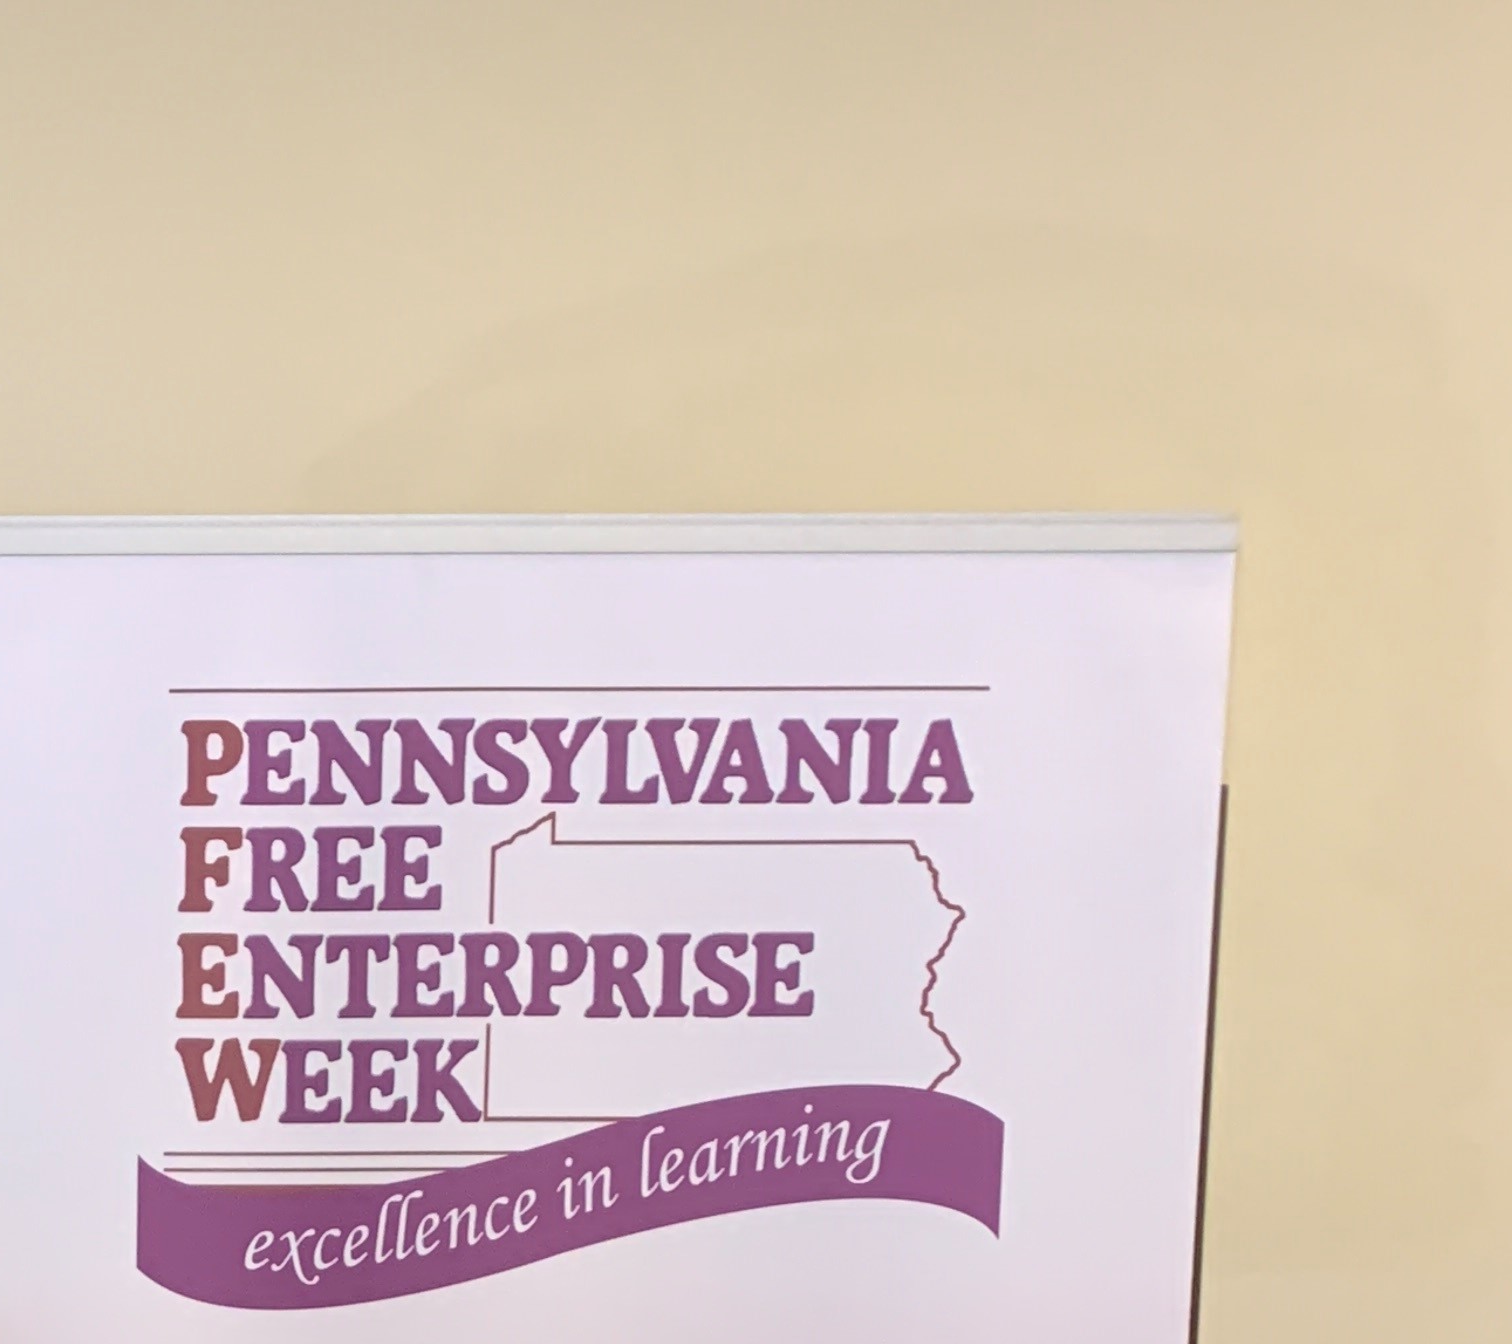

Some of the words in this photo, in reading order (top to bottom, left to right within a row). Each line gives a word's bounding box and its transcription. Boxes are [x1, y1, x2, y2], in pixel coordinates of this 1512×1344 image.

[177, 716, 974, 806] PENNSYLVANIA
[177, 825, 443, 912] FREE
[175, 932, 815, 1019] ENTERPRISE
[175, 1038, 484, 1123] WEEK
[243, 1187, 539, 1284] excellence
[557, 1155, 619, 1222] in
[641, 1103, 891, 1204] learning
